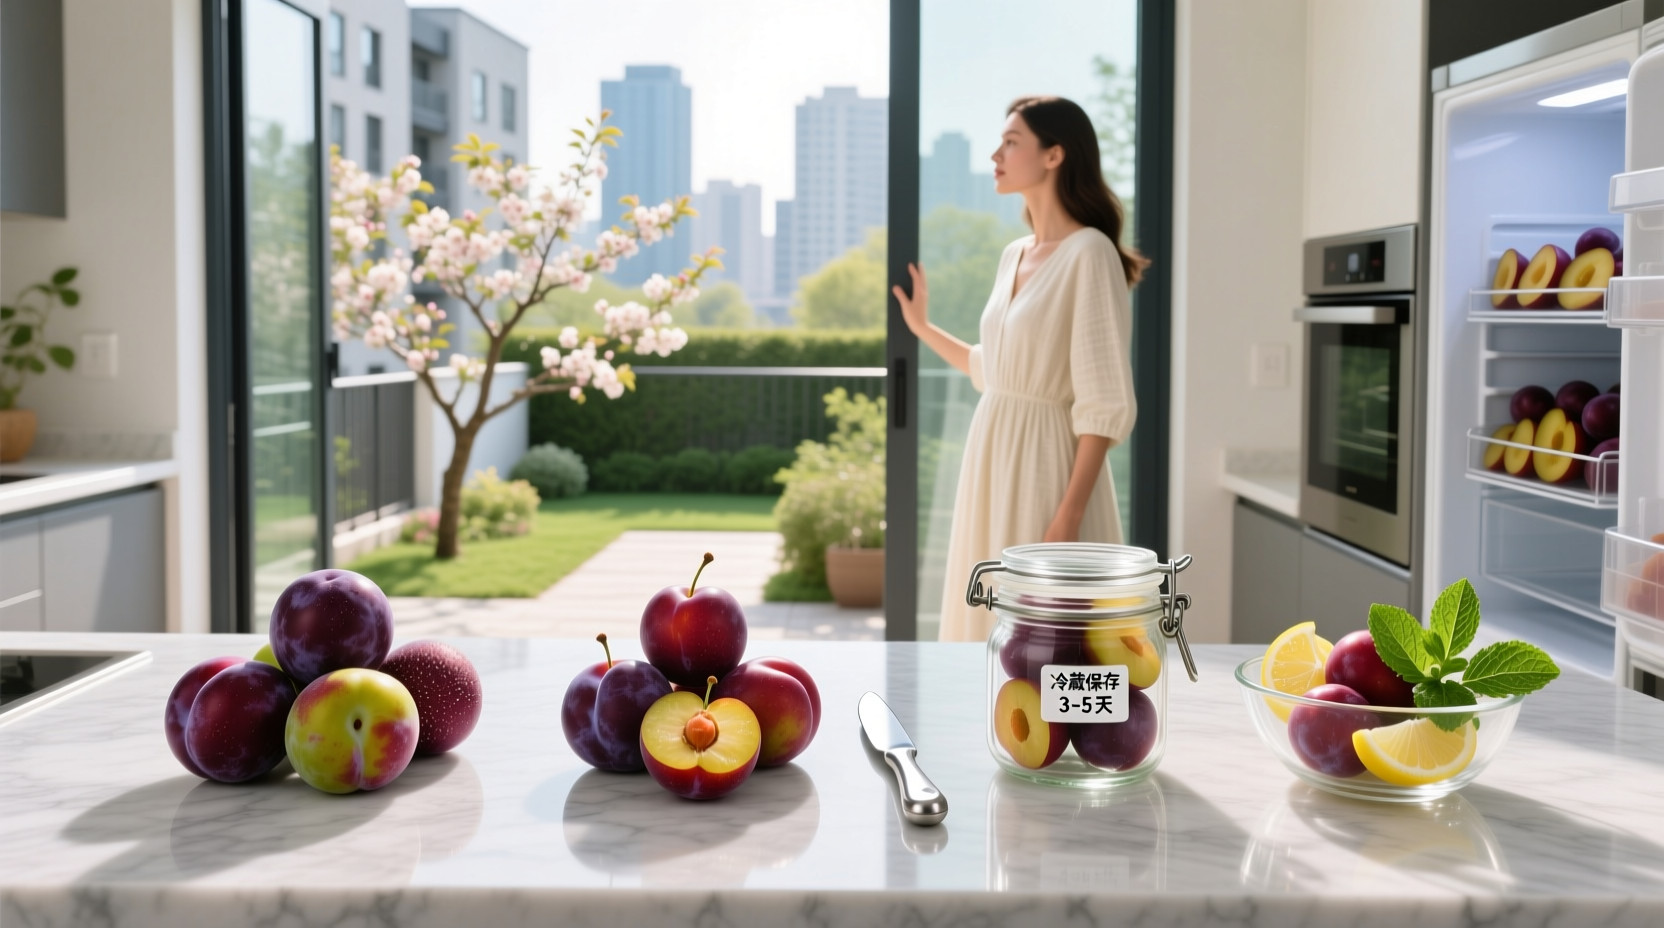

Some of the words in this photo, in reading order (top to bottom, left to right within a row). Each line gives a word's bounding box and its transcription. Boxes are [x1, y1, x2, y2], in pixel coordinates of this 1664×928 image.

[1050, 671, 1120, 692] 冷藏保存
[1059, 695, 1113, 714] 3-5天
